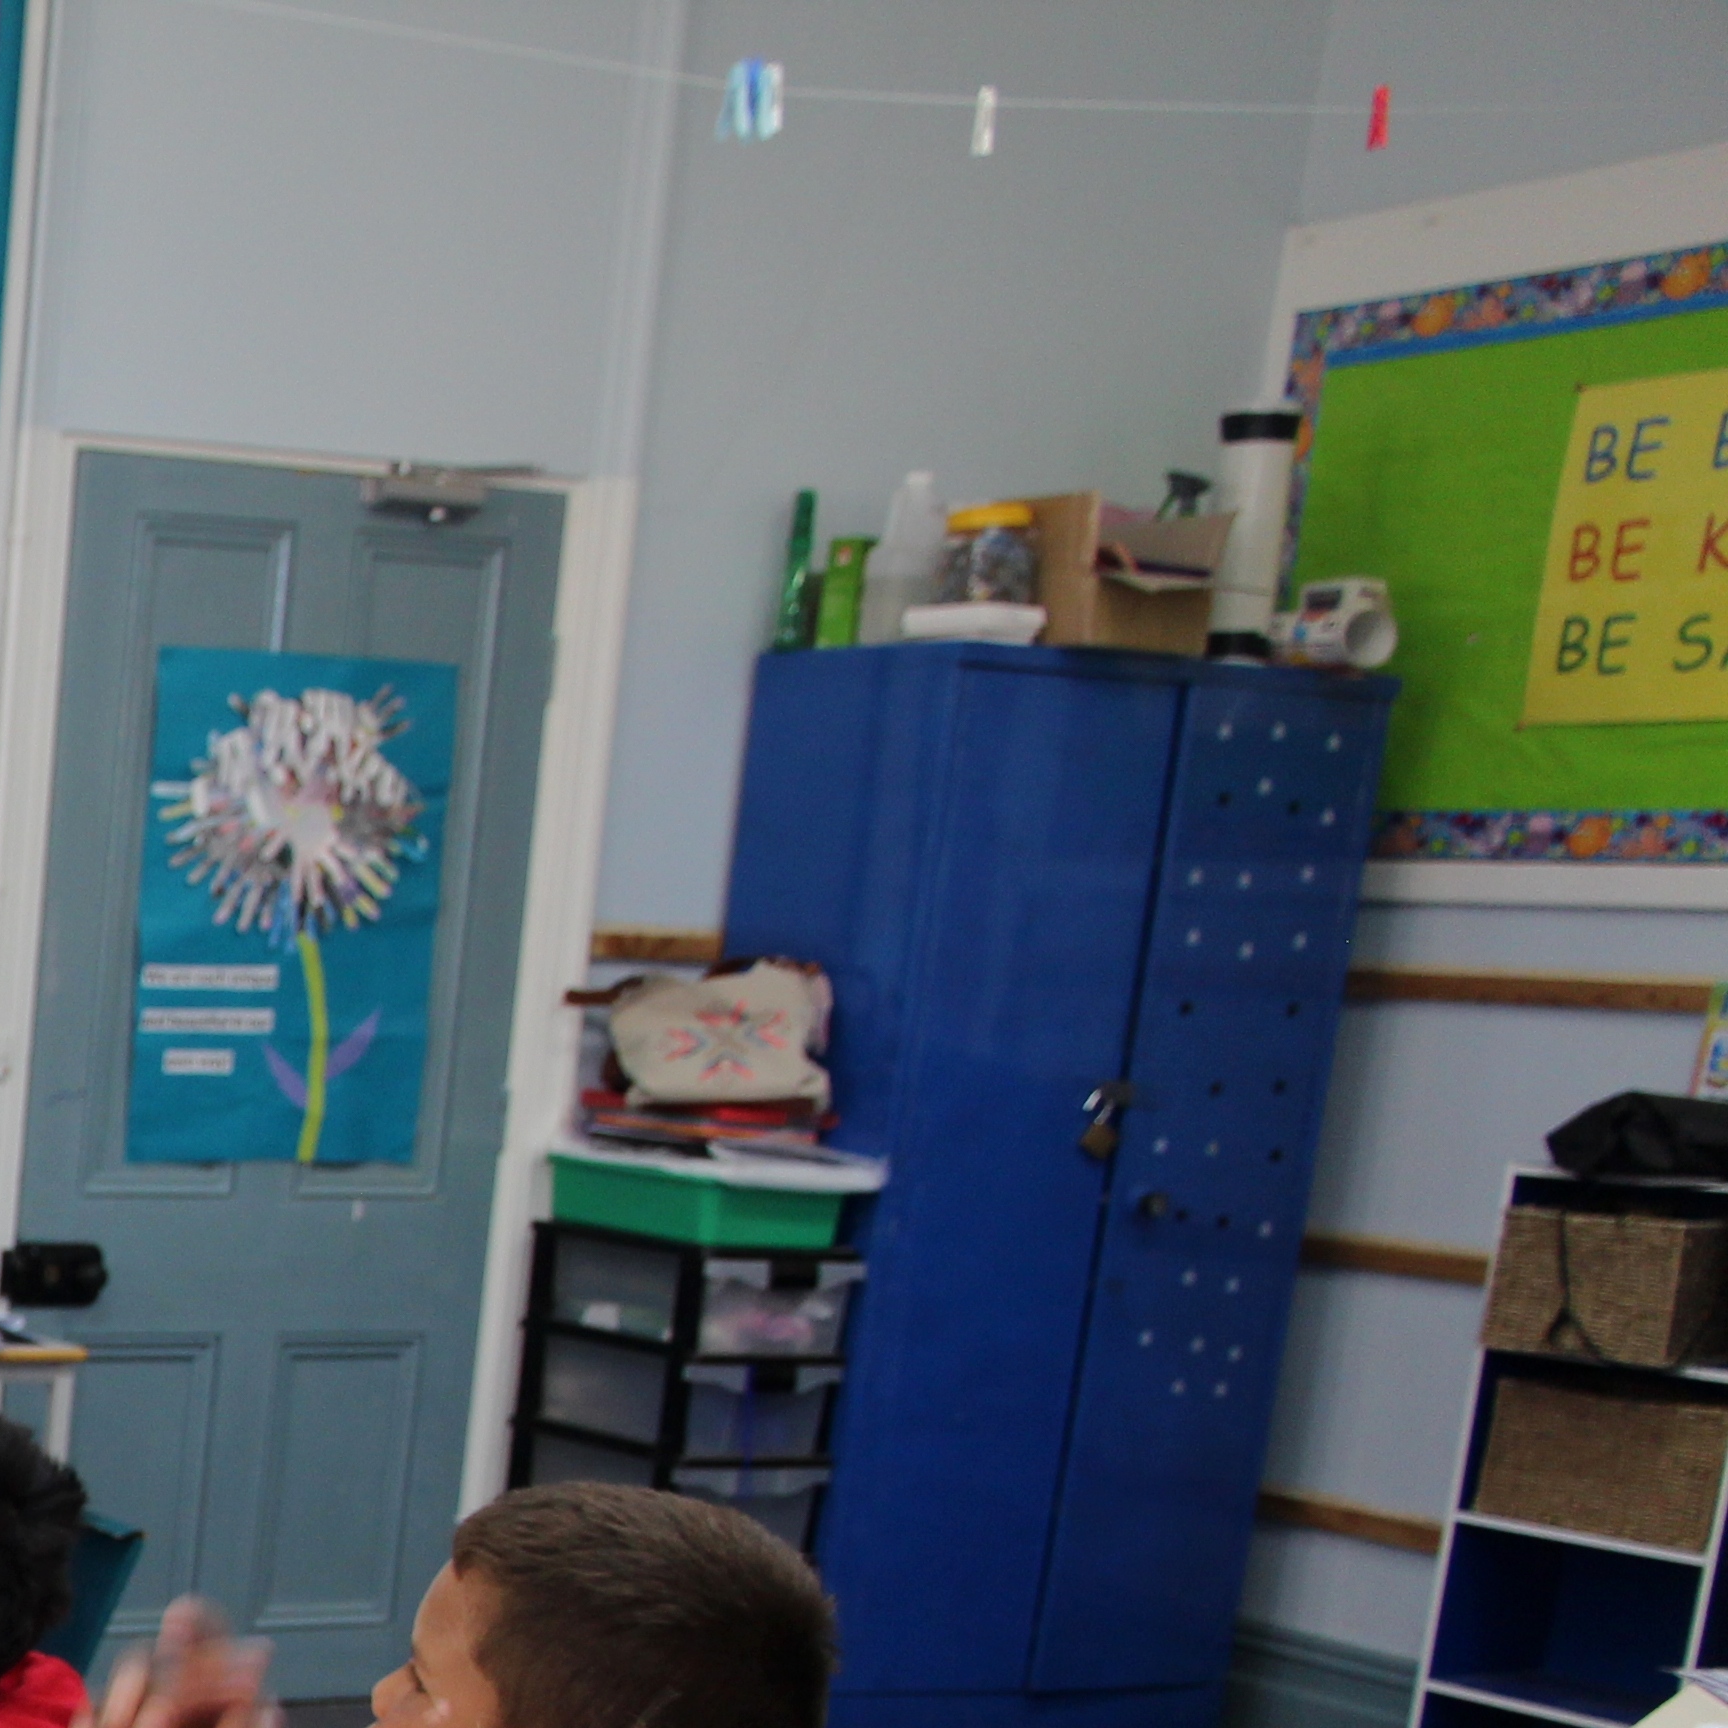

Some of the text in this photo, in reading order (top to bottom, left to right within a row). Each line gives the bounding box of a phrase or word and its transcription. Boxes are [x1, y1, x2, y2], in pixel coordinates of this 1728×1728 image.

[1585, 416, 1671, 484] BE
[1568, 518, 1652, 582] BE
[1556, 612, 1728, 676] BE S
